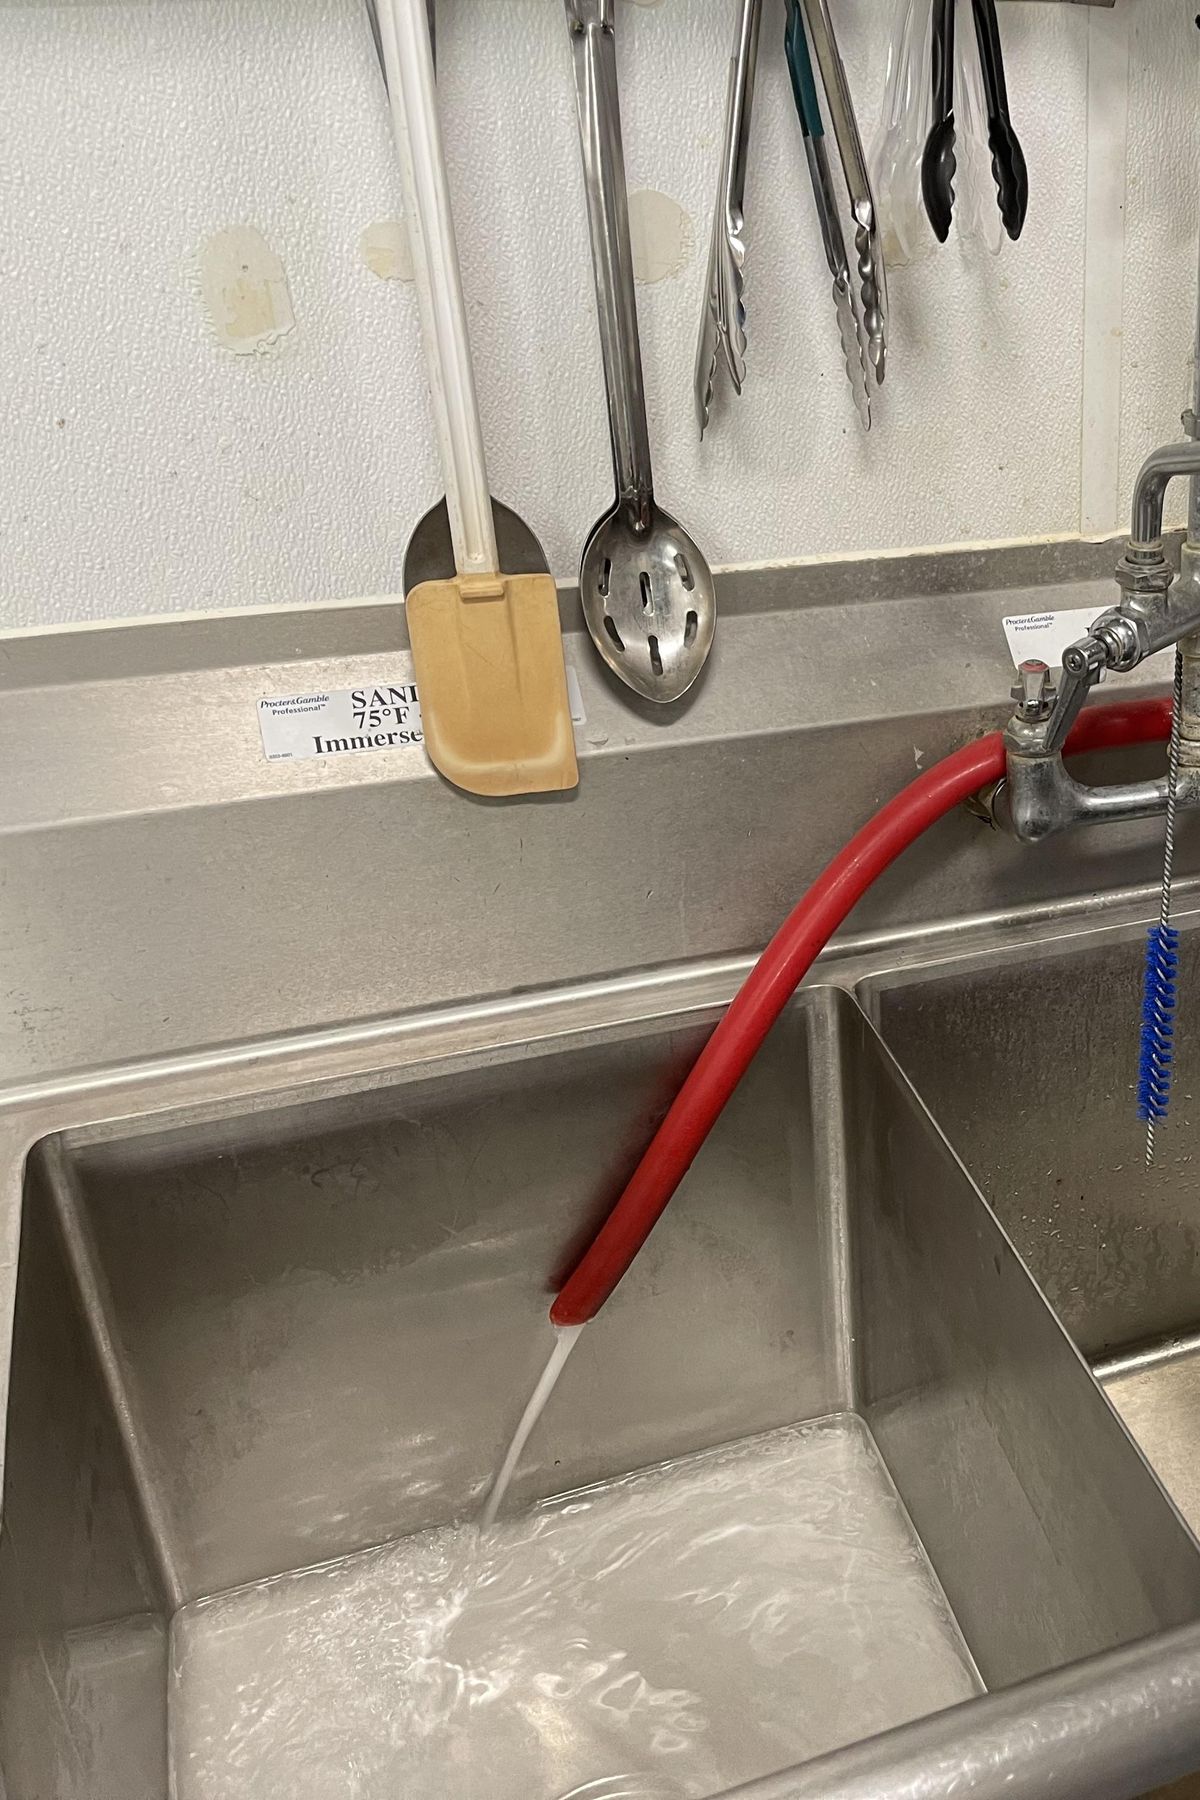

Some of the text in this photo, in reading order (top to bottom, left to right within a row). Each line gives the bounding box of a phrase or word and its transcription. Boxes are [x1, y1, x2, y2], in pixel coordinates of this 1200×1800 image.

[260, 694, 330, 709] Procter&Gamble
[352, 706, 410, 729] 75°F
[312, 729, 424, 754] Immerse
